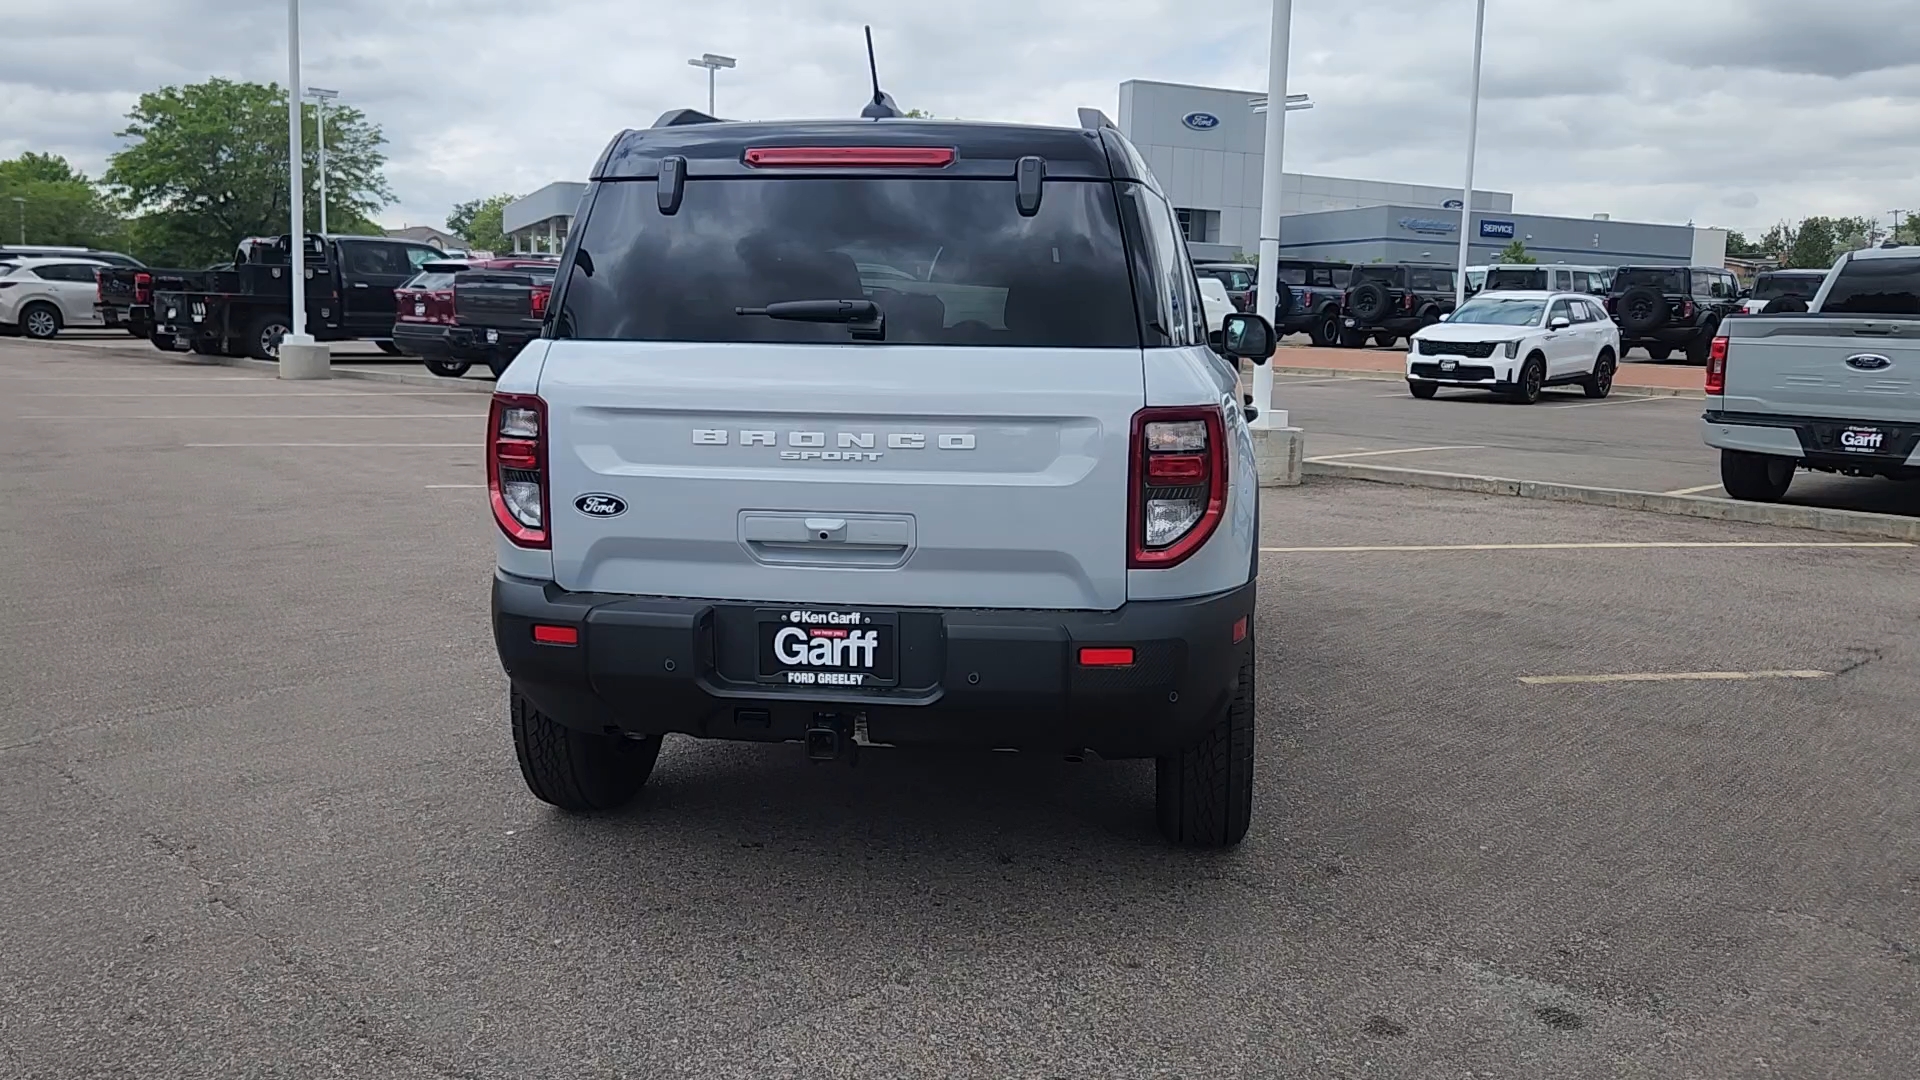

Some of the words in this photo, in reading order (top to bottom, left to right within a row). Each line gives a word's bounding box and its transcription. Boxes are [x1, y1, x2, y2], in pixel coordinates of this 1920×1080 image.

[1192, 115, 1213, 126] Ford
[1483, 223, 1513, 233] SERVICE
[692, 429, 976, 450] BRONCO
[1841, 431, 1883, 447] Garff
[779, 451, 884, 461] SPORT
[583, 497, 616, 513] Ford
[802, 611, 827, 623] Ken
[828, 612, 861, 624] Garff
[774, 627, 878, 667] Garff
[788, 673, 815, 684] FORD
[818, 673, 864, 685] GREELEY
